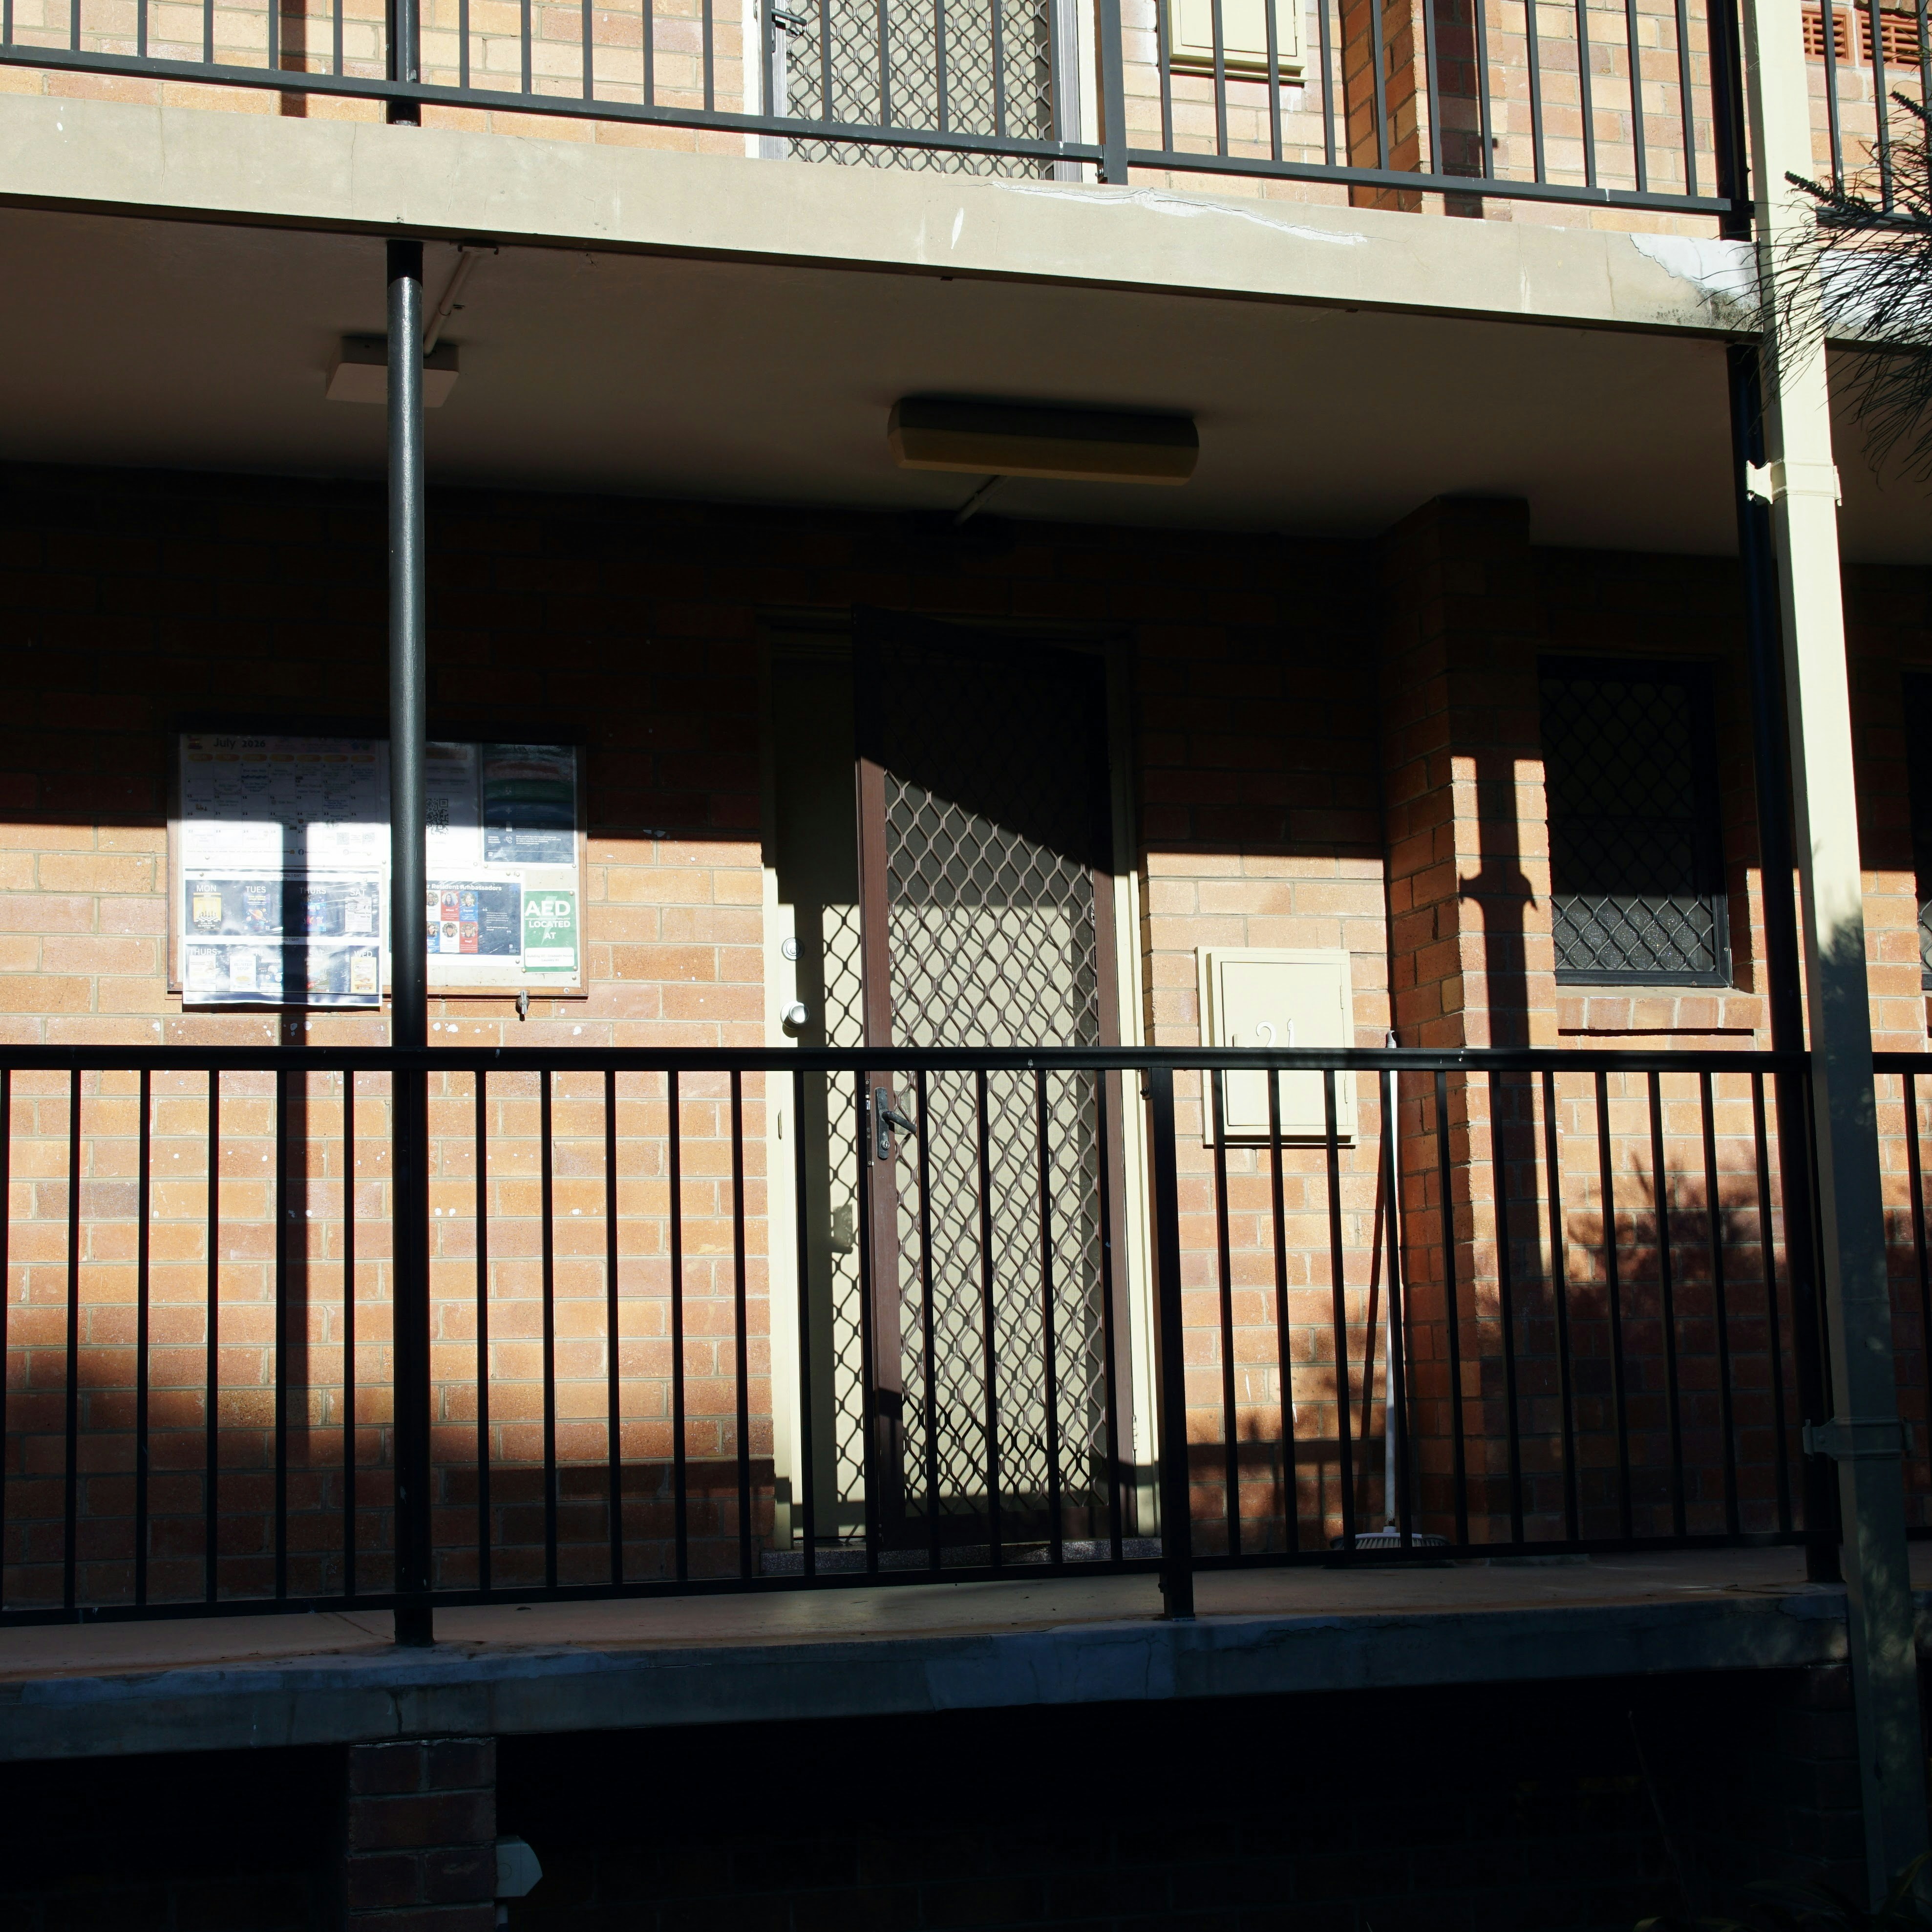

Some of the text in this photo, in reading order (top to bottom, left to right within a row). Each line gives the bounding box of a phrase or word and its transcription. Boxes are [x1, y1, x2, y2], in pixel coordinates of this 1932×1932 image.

[213, 738, 236, 750] July
[525, 901, 571, 916] AED
[1255, 1018, 1295, 1048] 21
